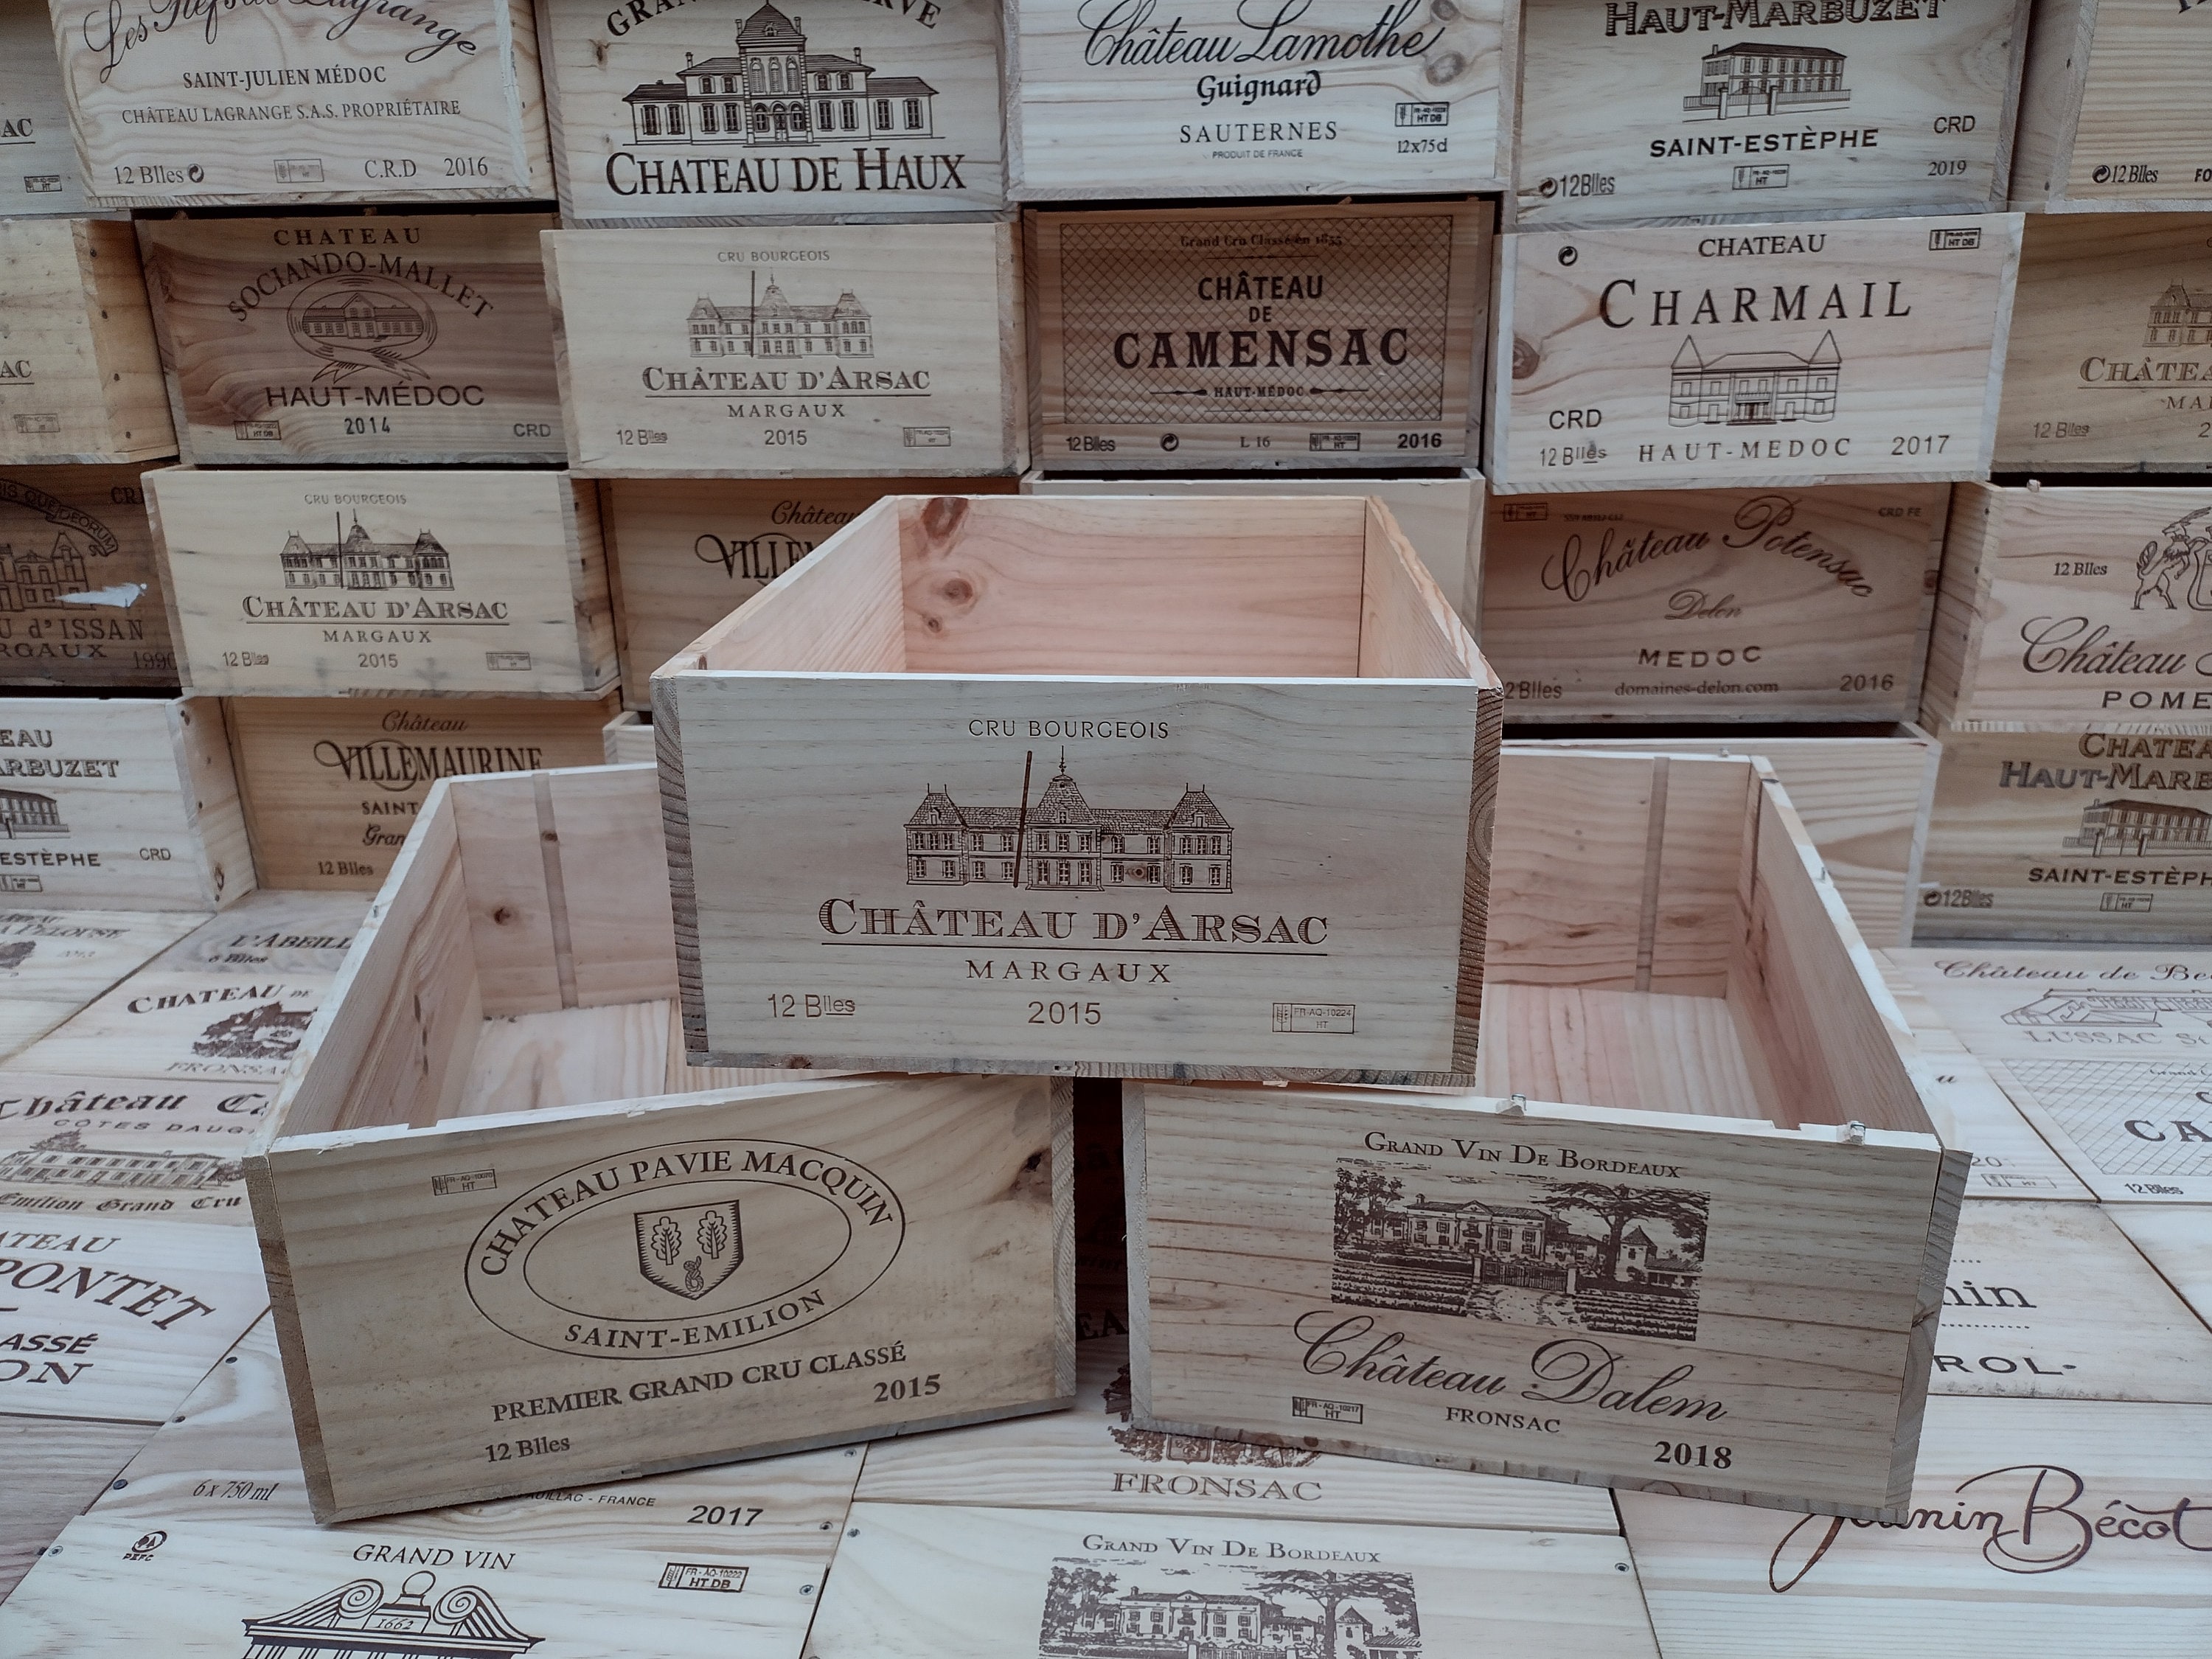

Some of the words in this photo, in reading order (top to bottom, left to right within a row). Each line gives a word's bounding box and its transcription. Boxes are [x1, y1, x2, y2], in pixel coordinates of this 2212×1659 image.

[1077, 0, 1242, 66] Château
[1234, 0, 1446, 62] Lamothe
[183, 69, 313, 91] SAINT-JULIEN
[316, 65, 387, 84] MÉDOC
[1196, 69, 1322, 105] Guignard
[122, 105, 198, 125] CHÂTEAU
[204, 105, 293, 122] LAGRANGE
[297, 104, 338, 120] S.A.S.
[342, 98, 461, 118] PROPRIÉTAIRE
[1180, 122, 1338, 145] SAUTERNES
[1649, 126, 1879, 158] SAINT-ESTÈPHE
[1933, 115, 1976, 135] CRD
[1212, 150, 1251, 159] PRODUIT
[1253, 150, 1265, 159] DE
[1267, 148, 1304, 158] FRANCE
[114, 167, 136, 186] 12
[141, 164, 184, 185] Blles
[365, 160, 417, 178] C.R.D
[445, 156, 488, 177] 2016
[606, 151, 780, 195] CHATEAU
[793, 156, 841, 192] DE
[853, 147, 966, 190] HAUX
[1927, 159, 1968, 177] 2019
[2111, 165, 2126, 183] 12
[274, 227, 421, 246] CHATEAU
[1698, 234, 1828, 258] CHATEAU
[717, 251, 745, 262] CRU
[751, 250, 830, 262] BOURGEOIS
[227, 251, 494, 322] SOCIANDO-MALLET
[1197, 271, 1324, 301] CHÂTEAU
[1599, 277, 1912, 330] CHARMAIL
[1248, 307, 1273, 323] DE
[1114, 328, 1409, 369] CAMENSAC
[642, 366, 788, 392] CHÂTEAU
[799, 365, 931, 391] D'ARSAC
[266, 380, 485, 408] HAUT-MÉDOC
[728, 404, 846, 418] MARGAUX
[1549, 409, 1602, 431] CRD
[344, 417, 392, 435] 2014
[512, 423, 552, 438] CRD
[616, 430, 634, 446] 12
[764, 429, 808, 446] 2015
[2034, 422, 2051, 439] 12
[1397, 433, 1443, 449] 2016
[1638, 438, 1851, 464] HAUT-MEDOC
[1891, 435, 1951, 457] 2017
[1540, 448, 1558, 467] 12
[304, 495, 330, 506] CRU
[335, 493, 407, 506] BOURGEOIS
[1541, 527, 1710, 602] Château
[1722, 495, 1874, 599] Potensac
[2053, 562, 2070, 577] 12
[242, 594, 376, 619] CHÂTEAU
[386, 596, 509, 619] D'ARSAC
[323, 630, 432, 644] MARGAUX
[2021, 616, 2186, 675] Château
[222, 652, 238, 667] 12
[358, 653, 399, 669] 2015
[1638, 645, 1764, 669] MEDOC
[1614, 678, 1779, 698] domaines-delon.com
[1839, 675, 1895, 692] 2016
[381, 709, 468, 732] Château
[969, 720, 1016, 737] CRU
[1029, 720, 1169, 740] BOURGEOIS
[139, 847, 172, 861] CRD
[318, 862, 335, 876] 12
[818, 897, 1074, 939] CHÂTEAU
[1092, 905, 1329, 945] D'ARSAC
[965, 959, 1172, 984] MARGAUX
[1934, 959, 2090, 980] Château
[2098, 964, 2140, 980] de
[127, 984, 286, 1015] CHATEAU
[768, 994, 795, 1019] 12
[1028, 1001, 1102, 1026] 2015
[1316, 1020, 1329, 1029] HT
[2023, 1029, 2162, 1045] LUSSAC
[462, 1181, 475, 1191] HT
[96, 1198, 175, 1212] Grand
[191, 1196, 243, 1210] Cru
[481, 1166, 622, 1276] CHATEAU
[630, 1150, 732, 1183] PAVIE
[740, 1150, 894, 1229] MACQUIN
[565, 1288, 826, 1349] SAINT-EMILION
[1294, 1310, 1507, 1397] Château
[1521, 1339, 1727, 1422] Dalem
[493, 1386, 622, 1423] PREMIER
[629, 1371, 733, 1402] GRAND
[742, 1358, 801, 1383] CRU
[810, 1340, 907, 1375] CLASSÉ
[873, 1373, 942, 1403] 2015
[1325, 1409, 1341, 1419] HT
[1446, 1405, 1561, 1434] FRONSAC
[485, 1442, 512, 1463] 12
[517, 1434, 571, 1459] Blles
[1653, 1440, 1733, 1470] 2018
[193, 1479, 205, 1498] 6
[204, 1485, 219, 1498] x
[220, 1481, 252, 1500] 750
[249, 1482, 280, 1501] ml
[1111, 1472, 1323, 1502] FRONSAC
[598, 1495, 657, 1507] FRANCE
[686, 1504, 764, 1527] 2017
[1955, 1464, 2212, 1573] Bécot
[122, 1553, 154, 1562] PEFC
[353, 1544, 454, 1566] GRAND
[464, 1551, 517, 1571] VIN
[689, 1577, 709, 1587] HT
[710, 1579, 731, 1589] DB
[374, 1617, 415, 1630] 1662
